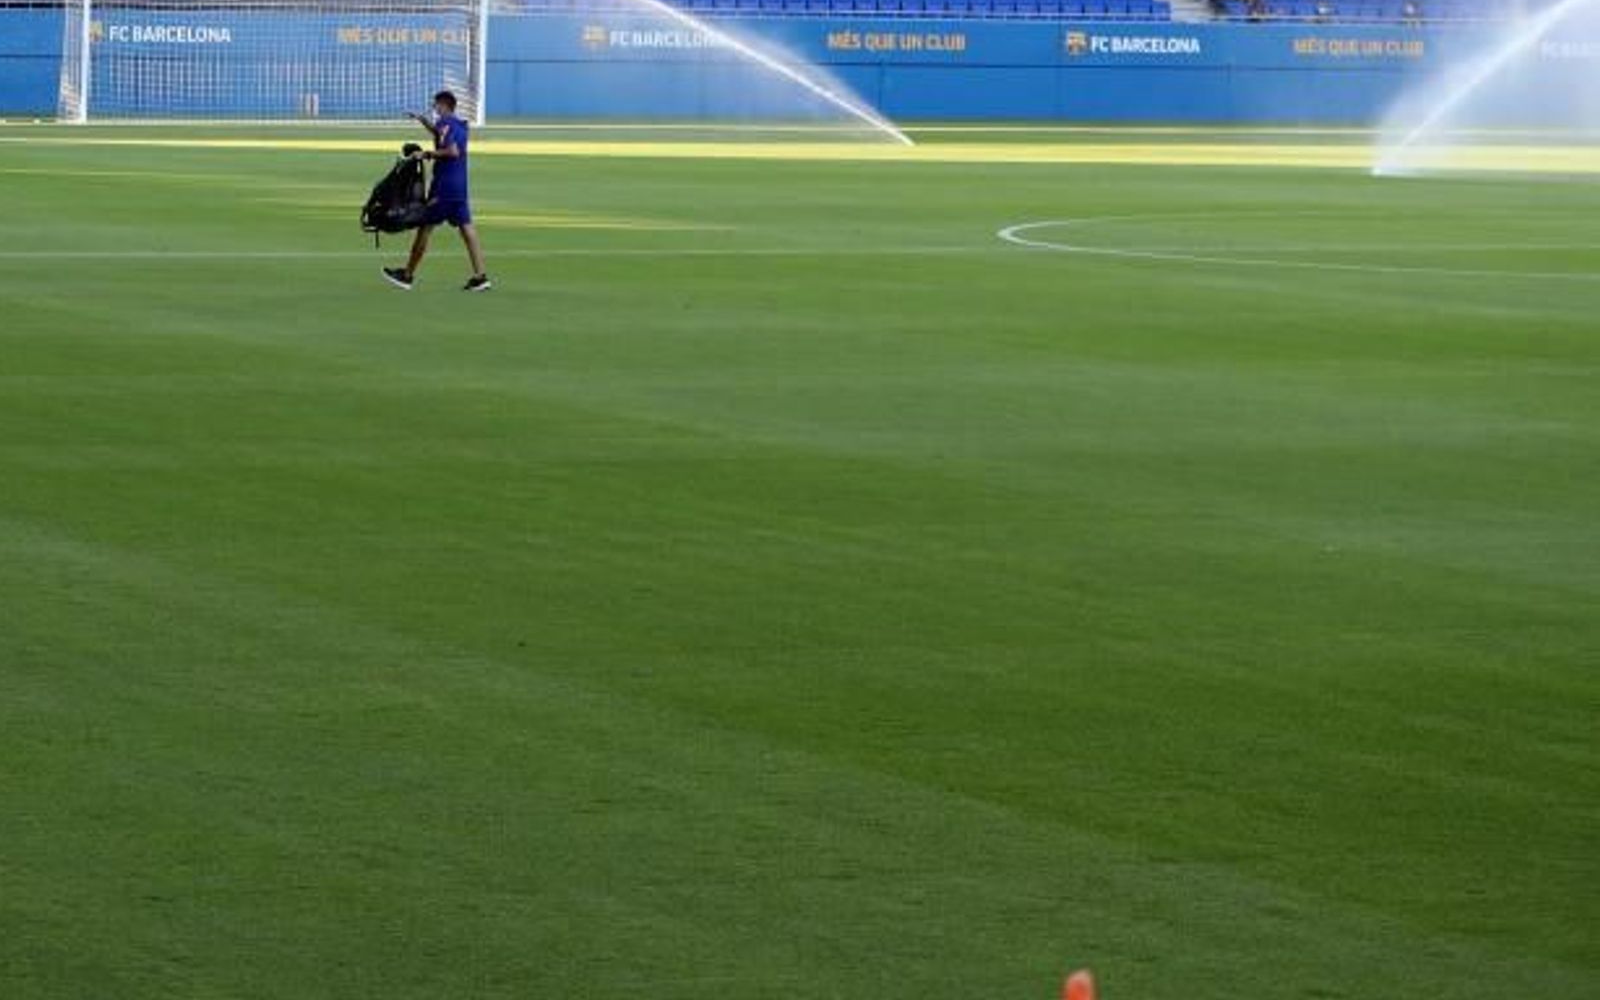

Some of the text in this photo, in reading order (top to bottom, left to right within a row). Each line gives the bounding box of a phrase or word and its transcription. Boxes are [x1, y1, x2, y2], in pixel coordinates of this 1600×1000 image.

[109, 25, 231, 42] FC BARCELONA
[865, 33, 897, 52] QUE
[900, 34, 922, 50] UN
[926, 34, 966, 51] CLUB
[1091, 36, 1200, 54] FC BARCELONA
